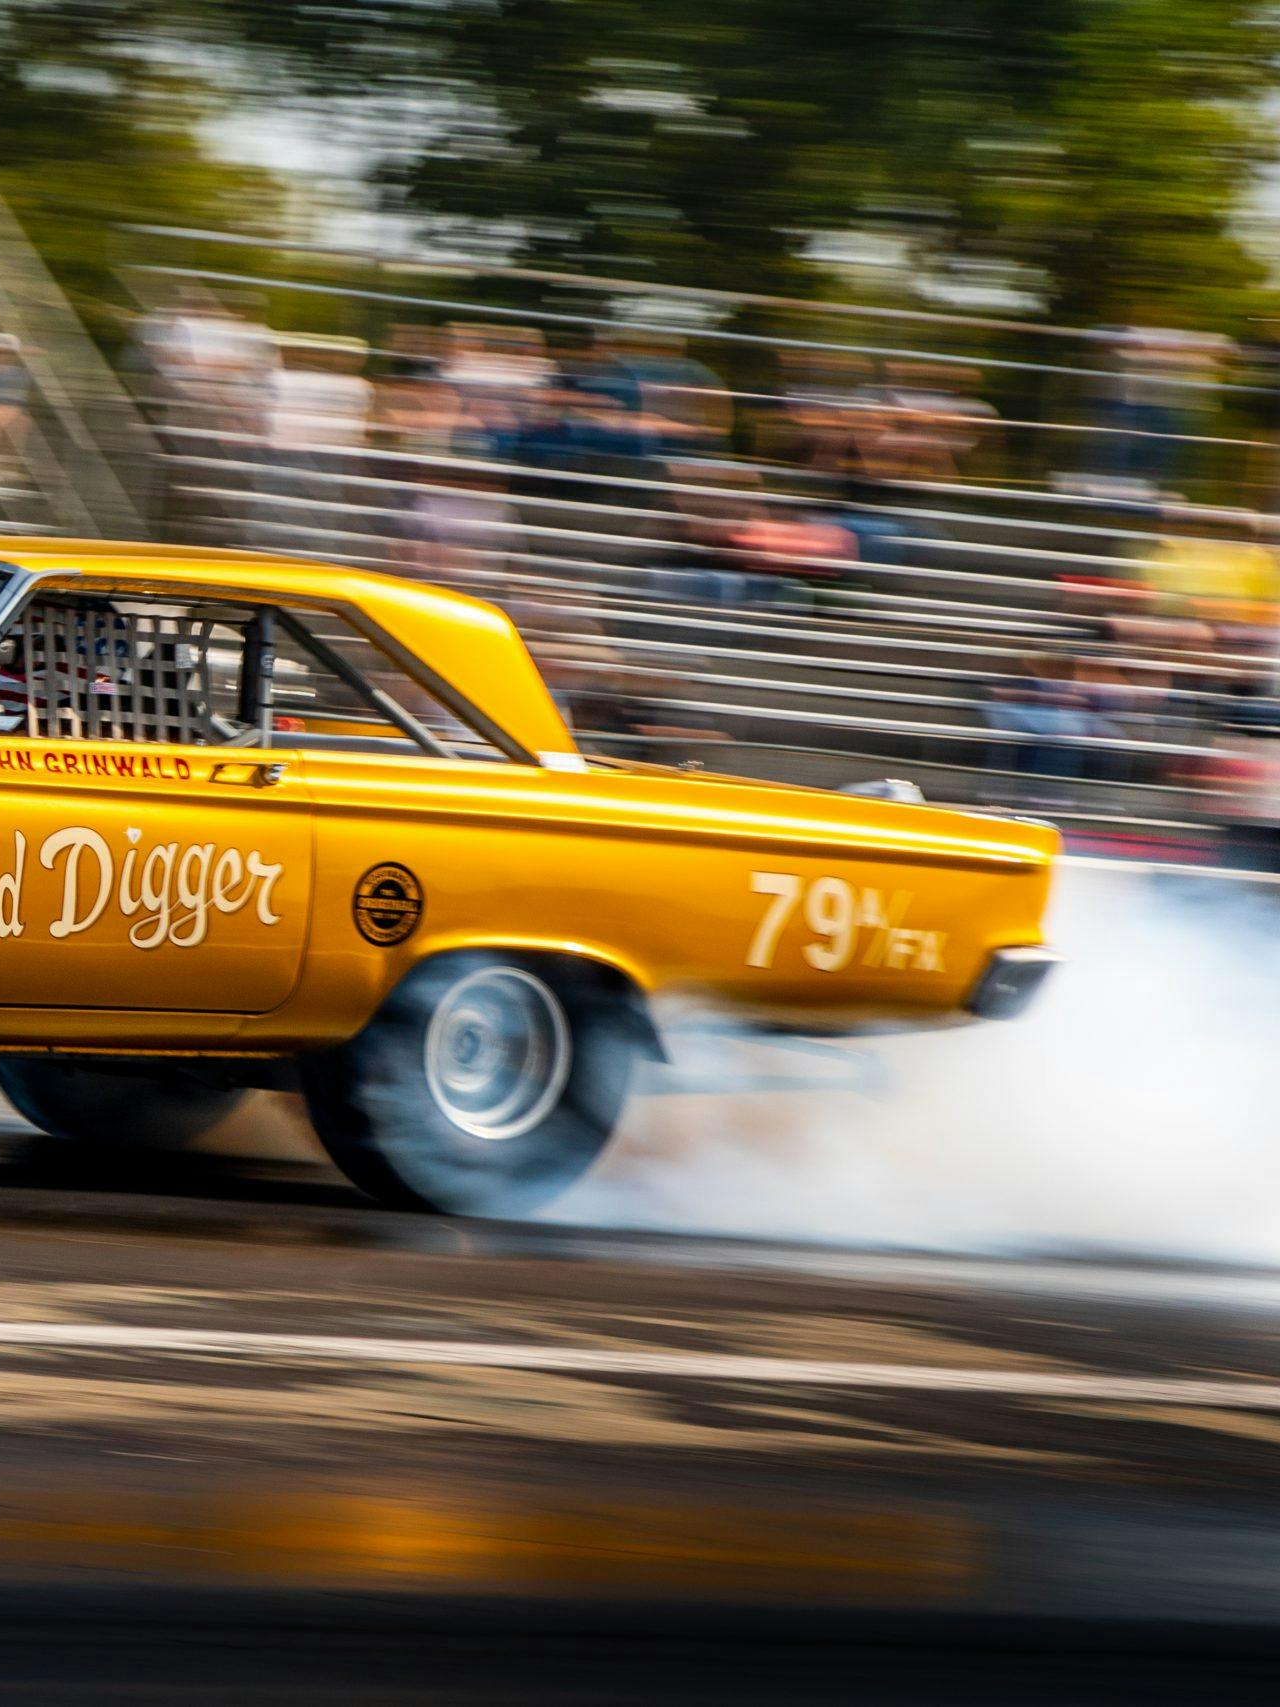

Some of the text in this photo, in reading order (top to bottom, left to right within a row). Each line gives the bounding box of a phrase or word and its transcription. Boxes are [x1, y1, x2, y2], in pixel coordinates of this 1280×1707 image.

[43, 752, 191, 780] GRINWALD
[38, 825, 286, 949] Digger
[744, 870, 858, 973] 79
